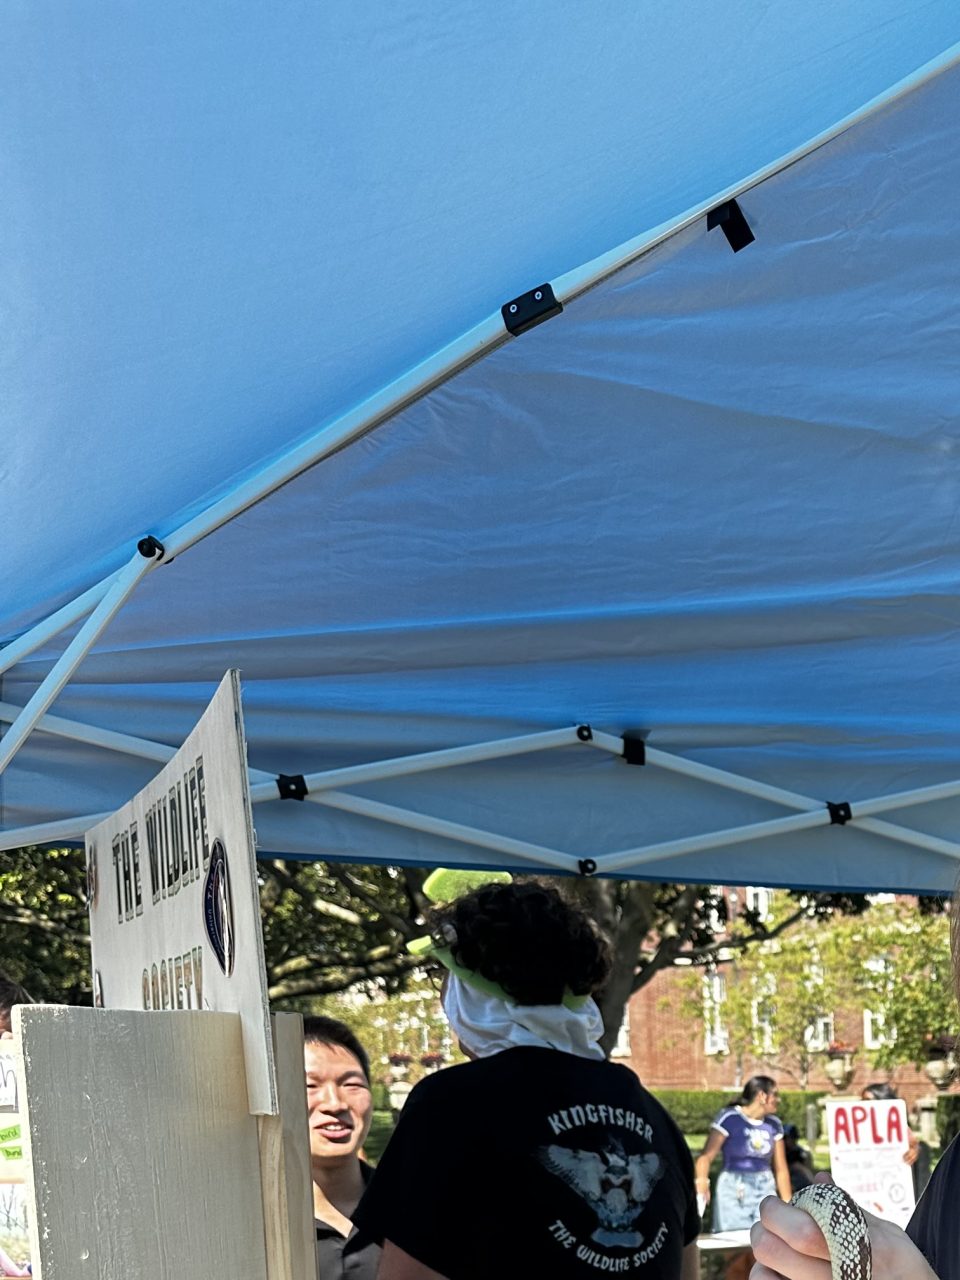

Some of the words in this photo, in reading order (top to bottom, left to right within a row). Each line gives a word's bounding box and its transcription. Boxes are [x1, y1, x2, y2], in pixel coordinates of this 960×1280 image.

[112, 821, 143, 924] THE
[145, 752, 210, 905] WILDLIFE
[548, 1103, 653, 1143] KINGFISHER
[834, 1106, 902, 1144] APLA
[549, 1219, 576, 1248] THE
[576, 1244, 629, 1272] WILDLIFE
[634, 1222, 669, 1267] SOCIETY
